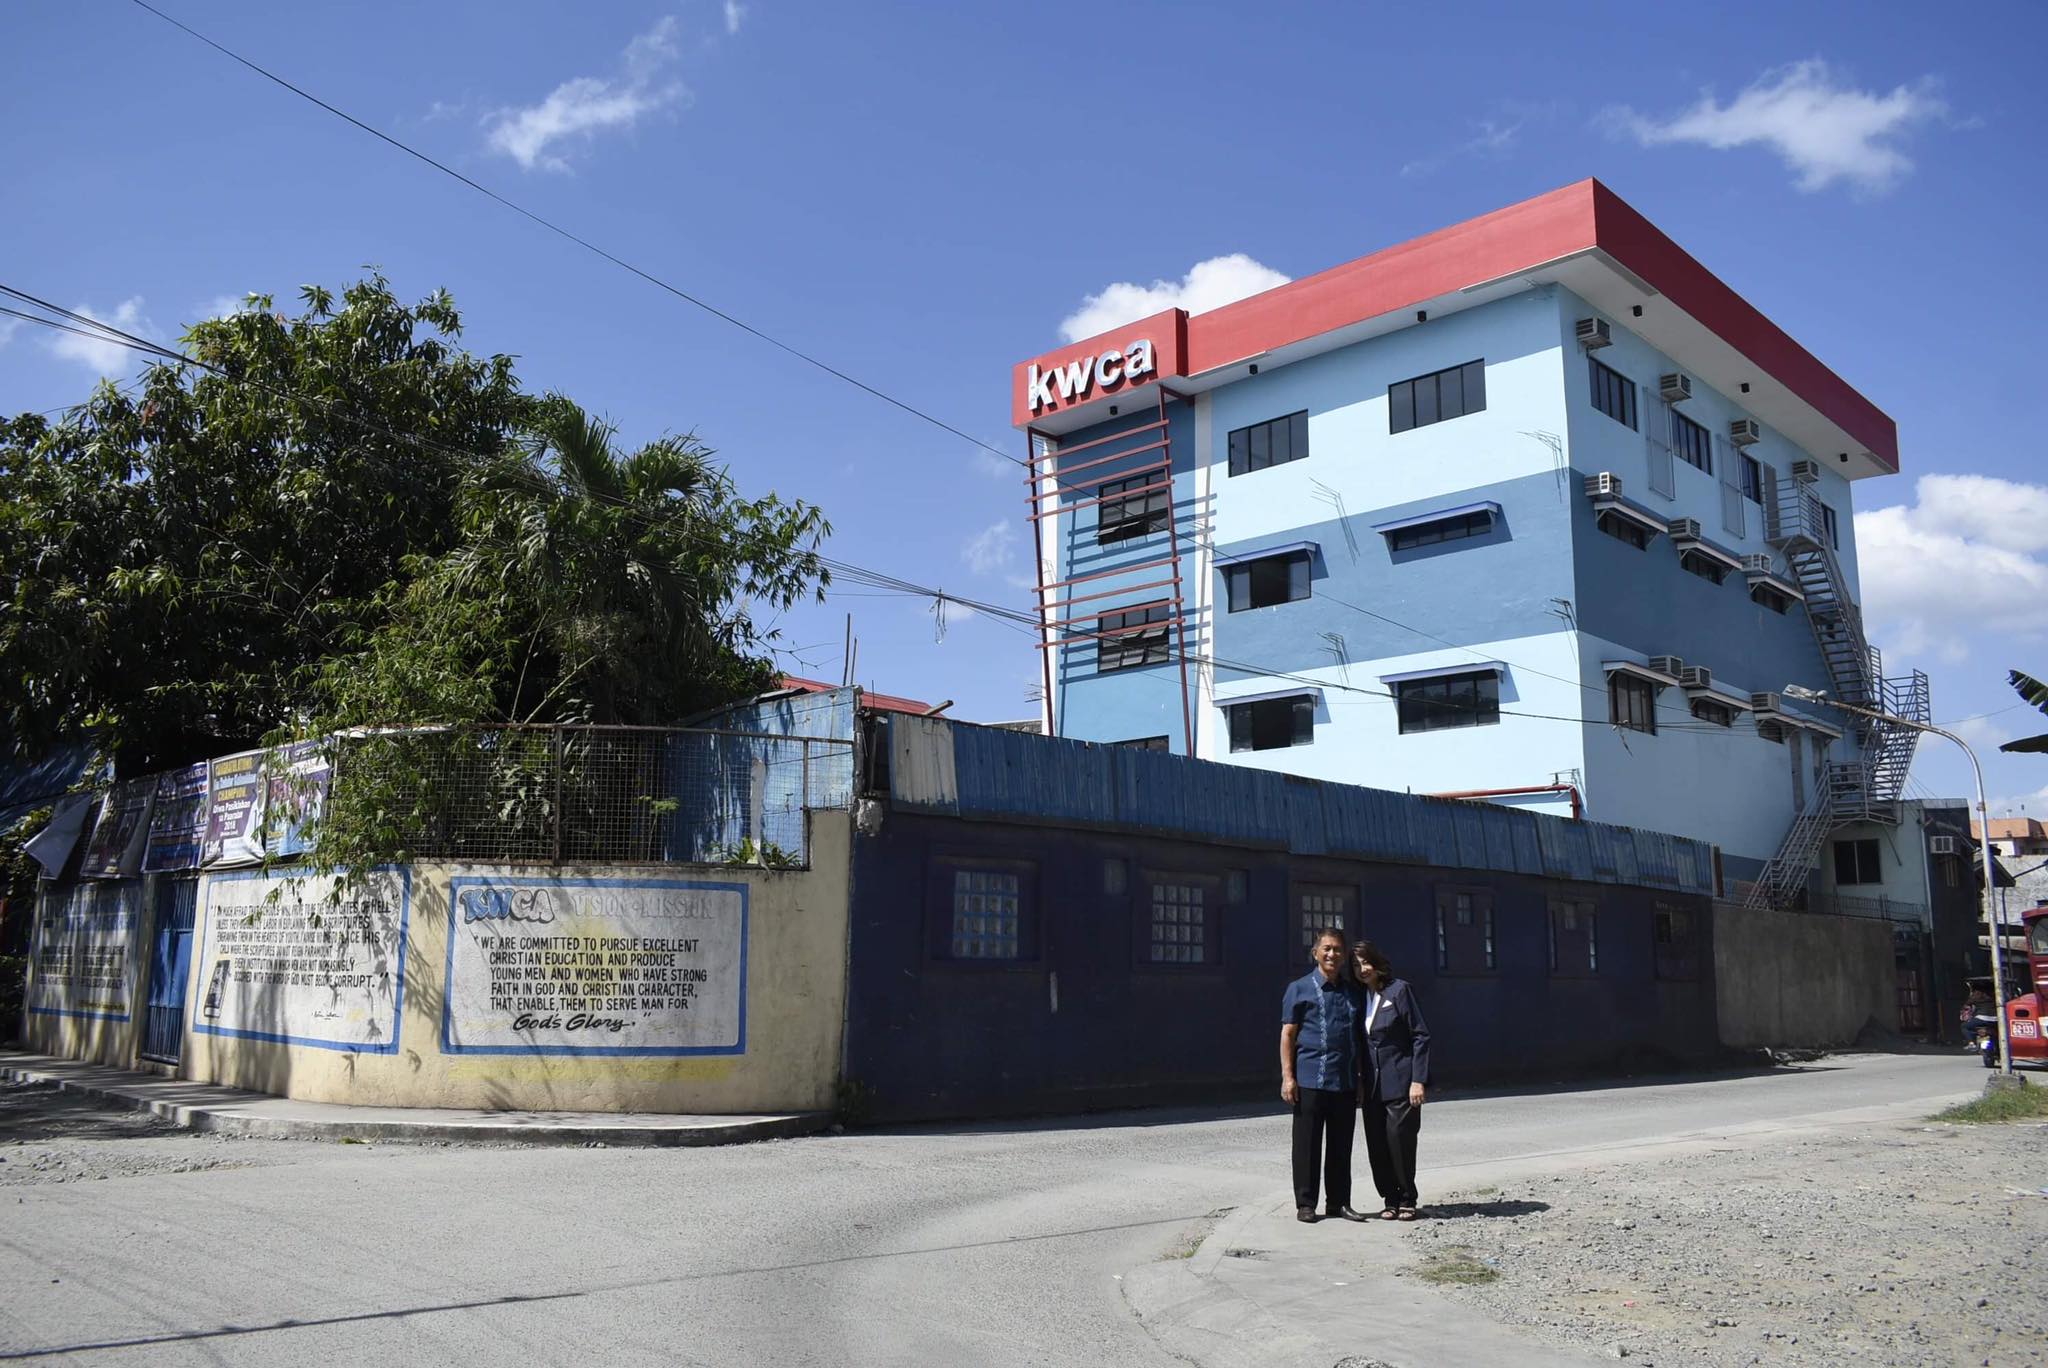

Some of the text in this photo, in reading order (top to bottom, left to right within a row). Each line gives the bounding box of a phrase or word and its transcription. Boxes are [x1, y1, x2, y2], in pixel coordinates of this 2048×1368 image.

[1028, 339, 1155, 411] kwca
[459, 888, 555, 924] KWCA
[499, 936, 517, 950] ARE
[520, 937, 580, 950] COMMITTED
[583, 937, 597, 951] TO
[600, 938, 639, 951] PURSUE
[642, 938, 699, 952] EXCELLENT
[490, 952, 675, 967] CHRISTIAN EDUCATION AND PRODUCE
[490, 967, 707, 983] YOUNG MEN AND WOMEN WHO HAVE STRONG
[491, 982, 698, 999] FAITH IN GOD AND CHRISTIAN CHARACTER,
[490, 997, 689, 1012] THAT ENABLE, THEM TO SERVE MAN FOR
[512, 1012, 561, 1032] God's
